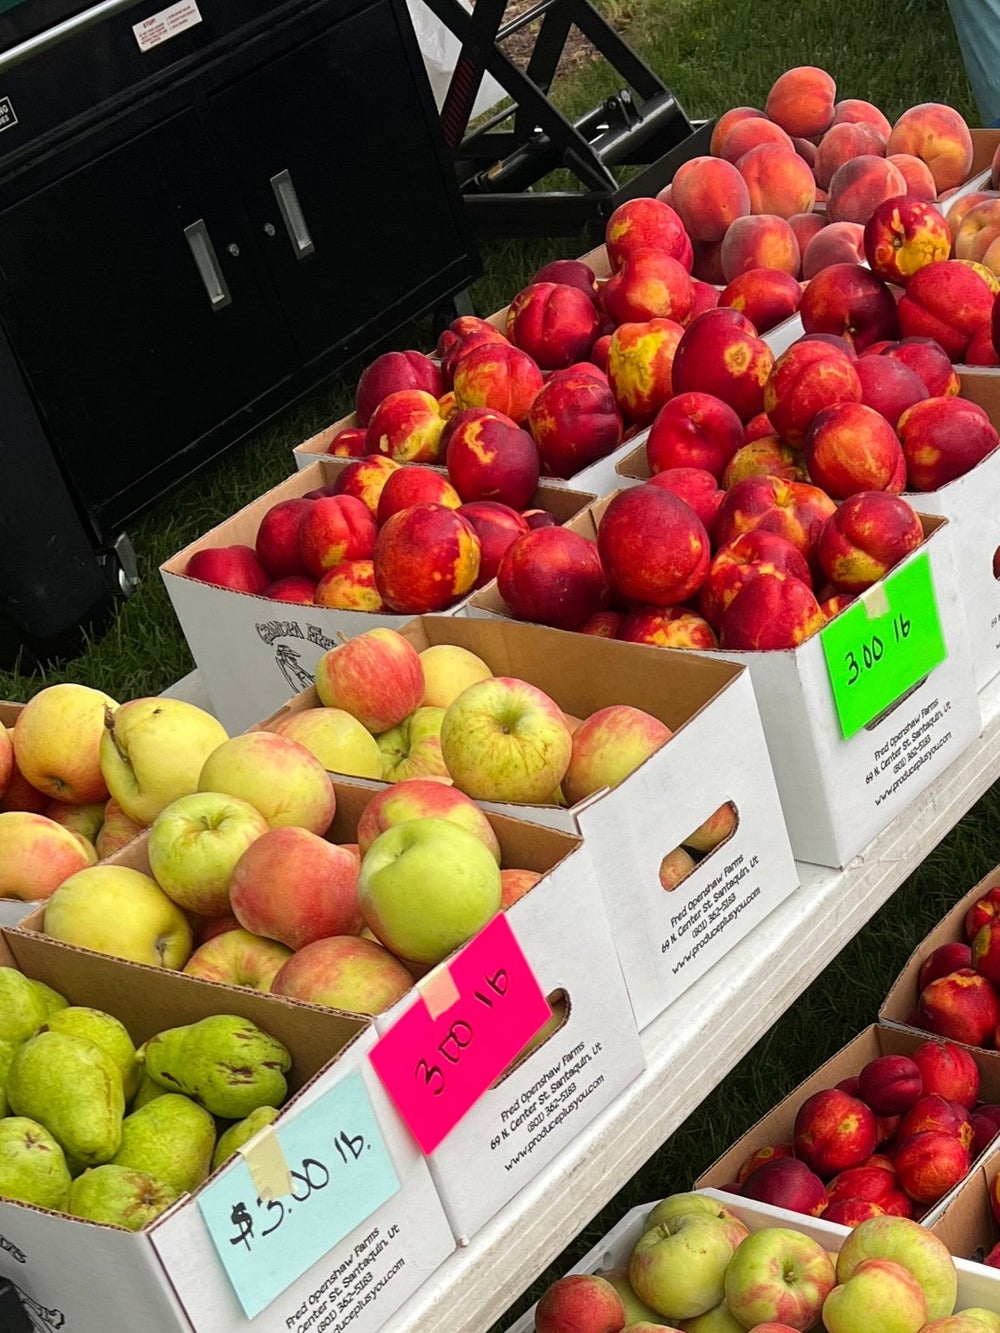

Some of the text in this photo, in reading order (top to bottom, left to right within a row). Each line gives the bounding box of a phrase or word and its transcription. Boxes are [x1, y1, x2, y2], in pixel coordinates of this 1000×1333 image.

[844, 635, 884, 686] 3.00
[671, 855, 744, 929] Fred Openshaw Farms
[662, 940, 670, 954] 69
[678, 910, 702, 937] Center
[672, 887, 761, 975] www.produceplusyou.com
[501, 1042, 585, 1123] Fred Openshaw Farms
[528, 1083, 577, 1133] (801) 362-5183
[491, 1136, 501, 1151] 69
[510, 1102, 537, 1132] Center
[505, 1075, 605, 1172] www.produceplusyou.com
[286, 1228, 380, 1330] Fred Openshaw Farms
[318, 1272, 374, 1333] (801) 362-5183
